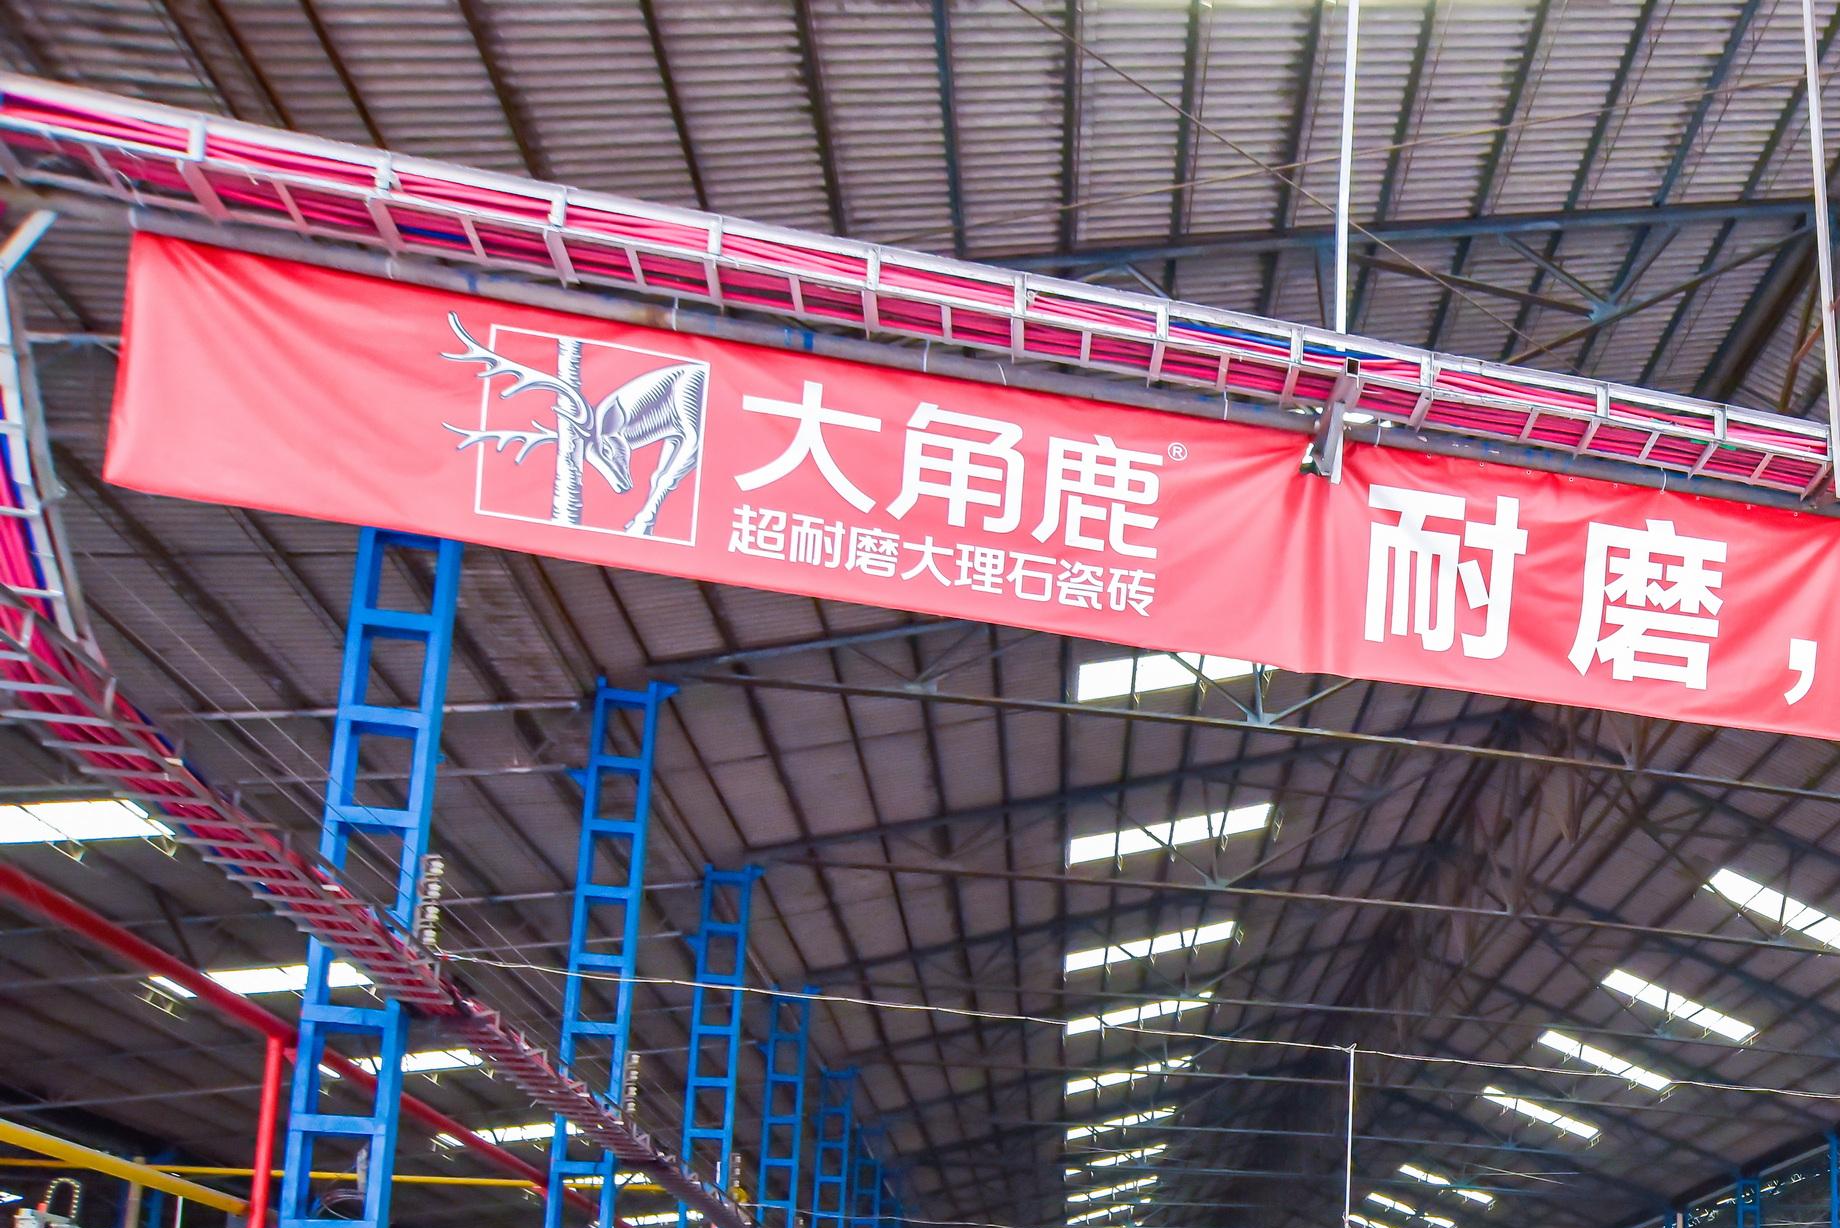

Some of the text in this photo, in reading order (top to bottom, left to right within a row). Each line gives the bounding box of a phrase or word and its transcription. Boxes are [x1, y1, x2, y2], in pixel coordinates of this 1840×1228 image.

[733, 380, 1163, 559] 大角鹿
[727, 504, 1156, 617] 超耐磨大理石瓷砖
